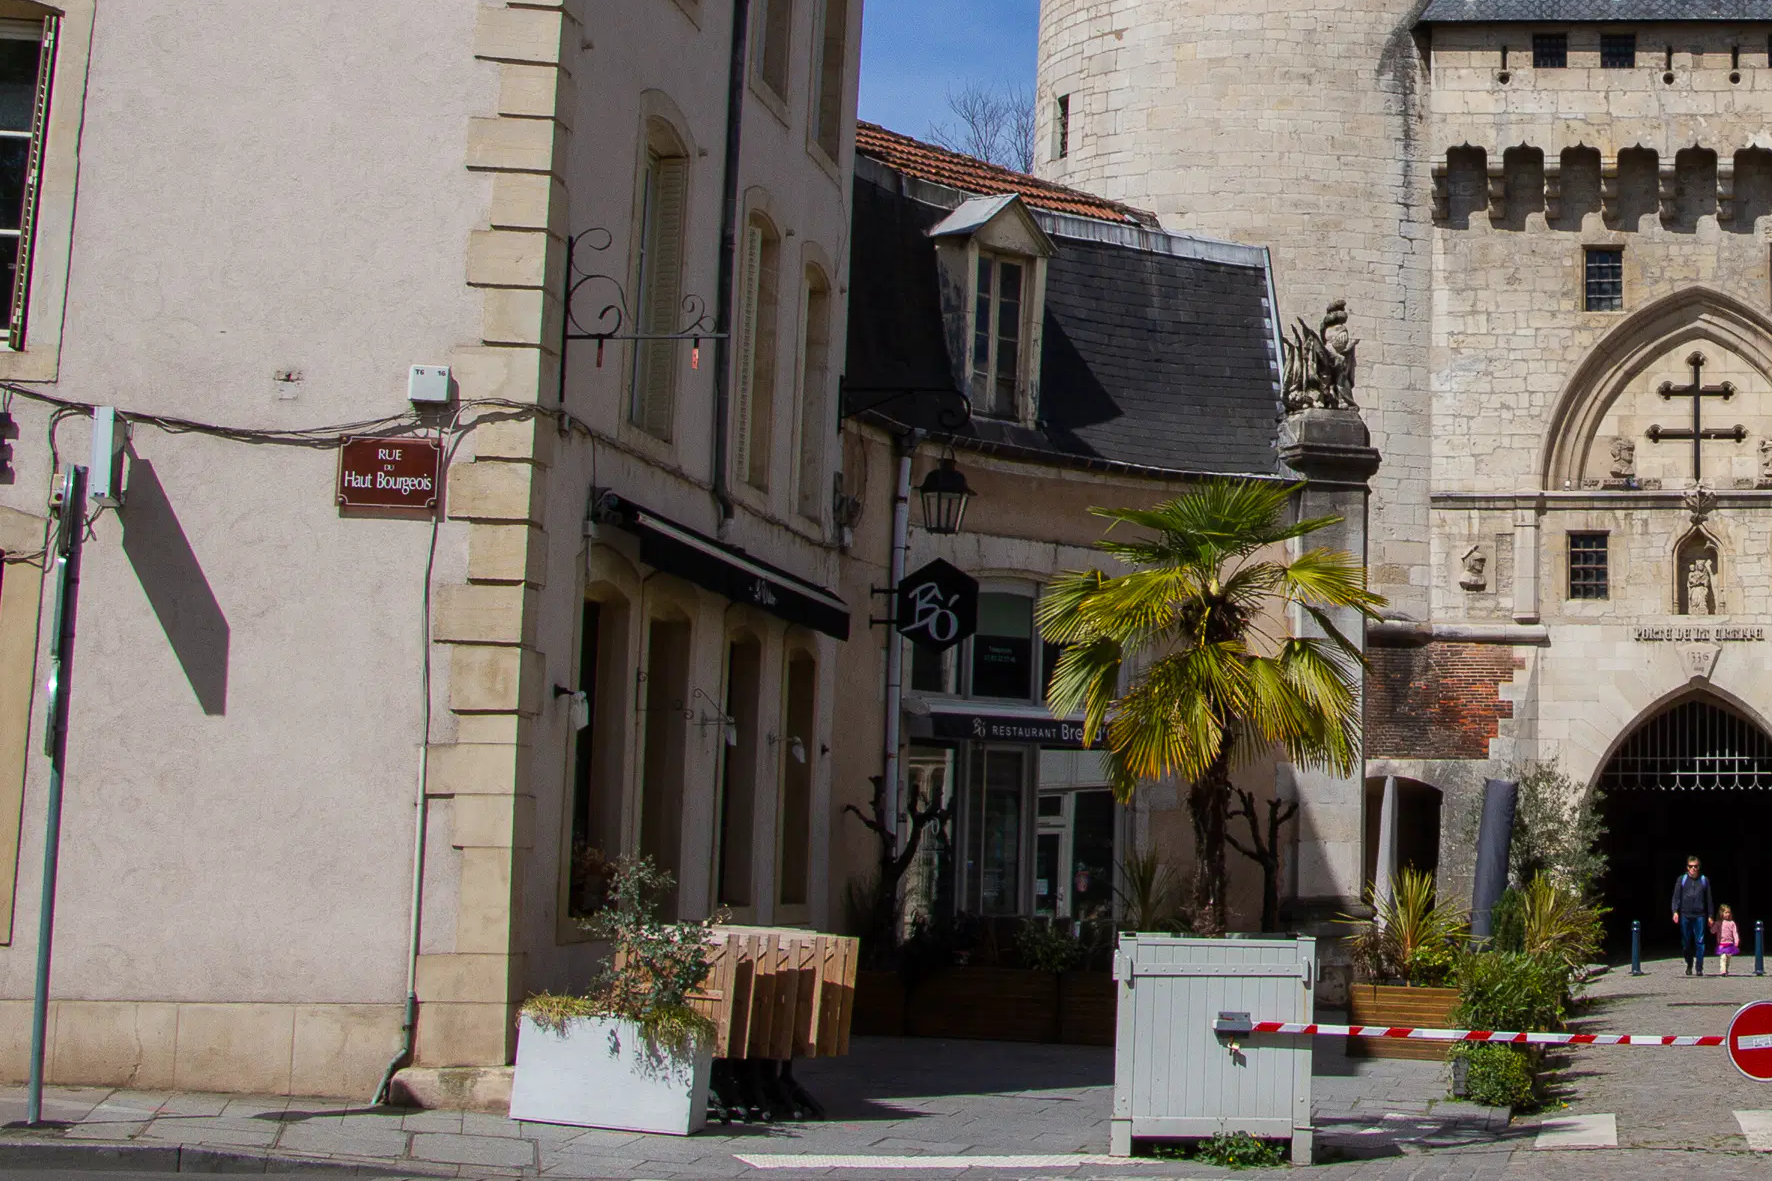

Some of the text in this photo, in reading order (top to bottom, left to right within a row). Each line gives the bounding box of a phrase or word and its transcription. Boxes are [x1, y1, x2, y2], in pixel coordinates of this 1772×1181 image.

[378, 449, 402, 460] RUE
[344, 471, 432, 495] Haut Bourgeois
[992, 725, 1057, 739] RESTAURANT
